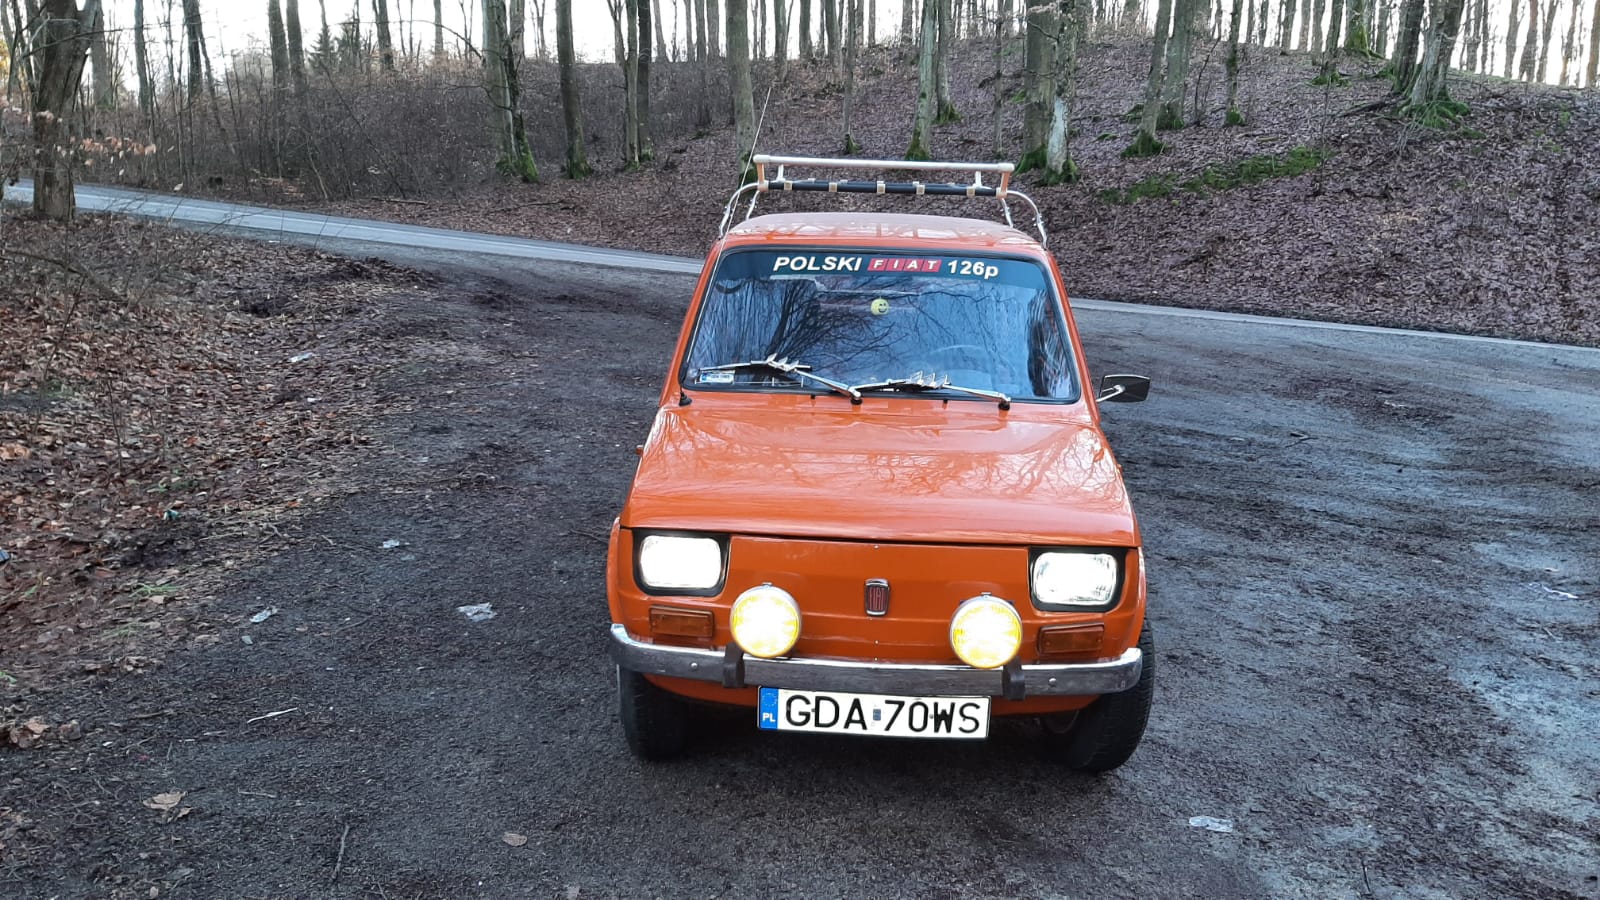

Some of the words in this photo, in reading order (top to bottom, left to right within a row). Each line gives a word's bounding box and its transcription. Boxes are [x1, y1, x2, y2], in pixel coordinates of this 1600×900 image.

[773, 256, 863, 272] POLSKI
[871, 259, 939, 270] FIAT
[947, 259, 999, 280] 126p
[762, 712, 776, 723] PL
[785, 694, 868, 731] GDA
[884, 699, 981, 734] 70WS
